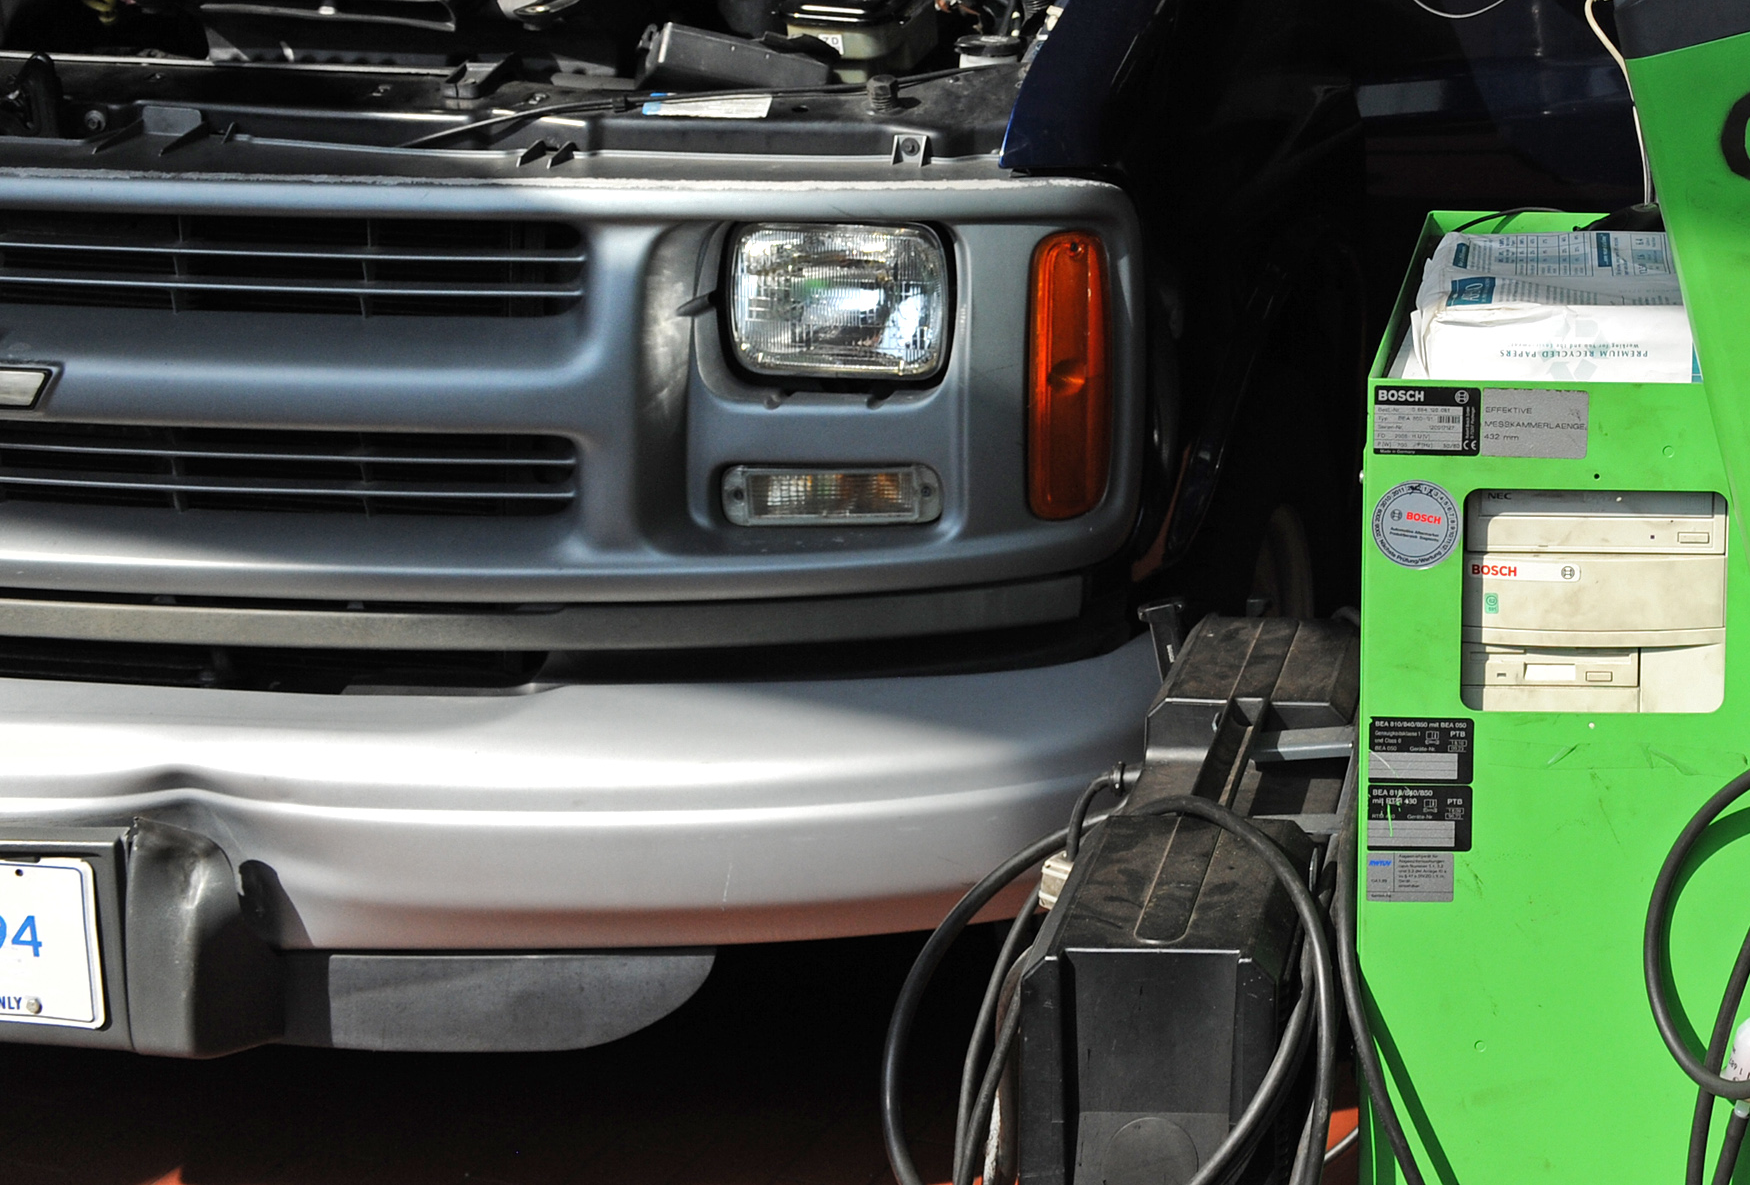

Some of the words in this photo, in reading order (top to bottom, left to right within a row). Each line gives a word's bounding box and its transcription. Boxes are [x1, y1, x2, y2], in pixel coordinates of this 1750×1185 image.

[1500, 350, 1536, 358] PAPERS
[1378, 390, 1424, 402] BOSCH
[1392, 487, 1405, 496] 2011
[1381, 496, 1392, 509] 2010
[1406, 512, 1442, 524] BOSCH
[1472, 564, 1517, 576] BOSCH
